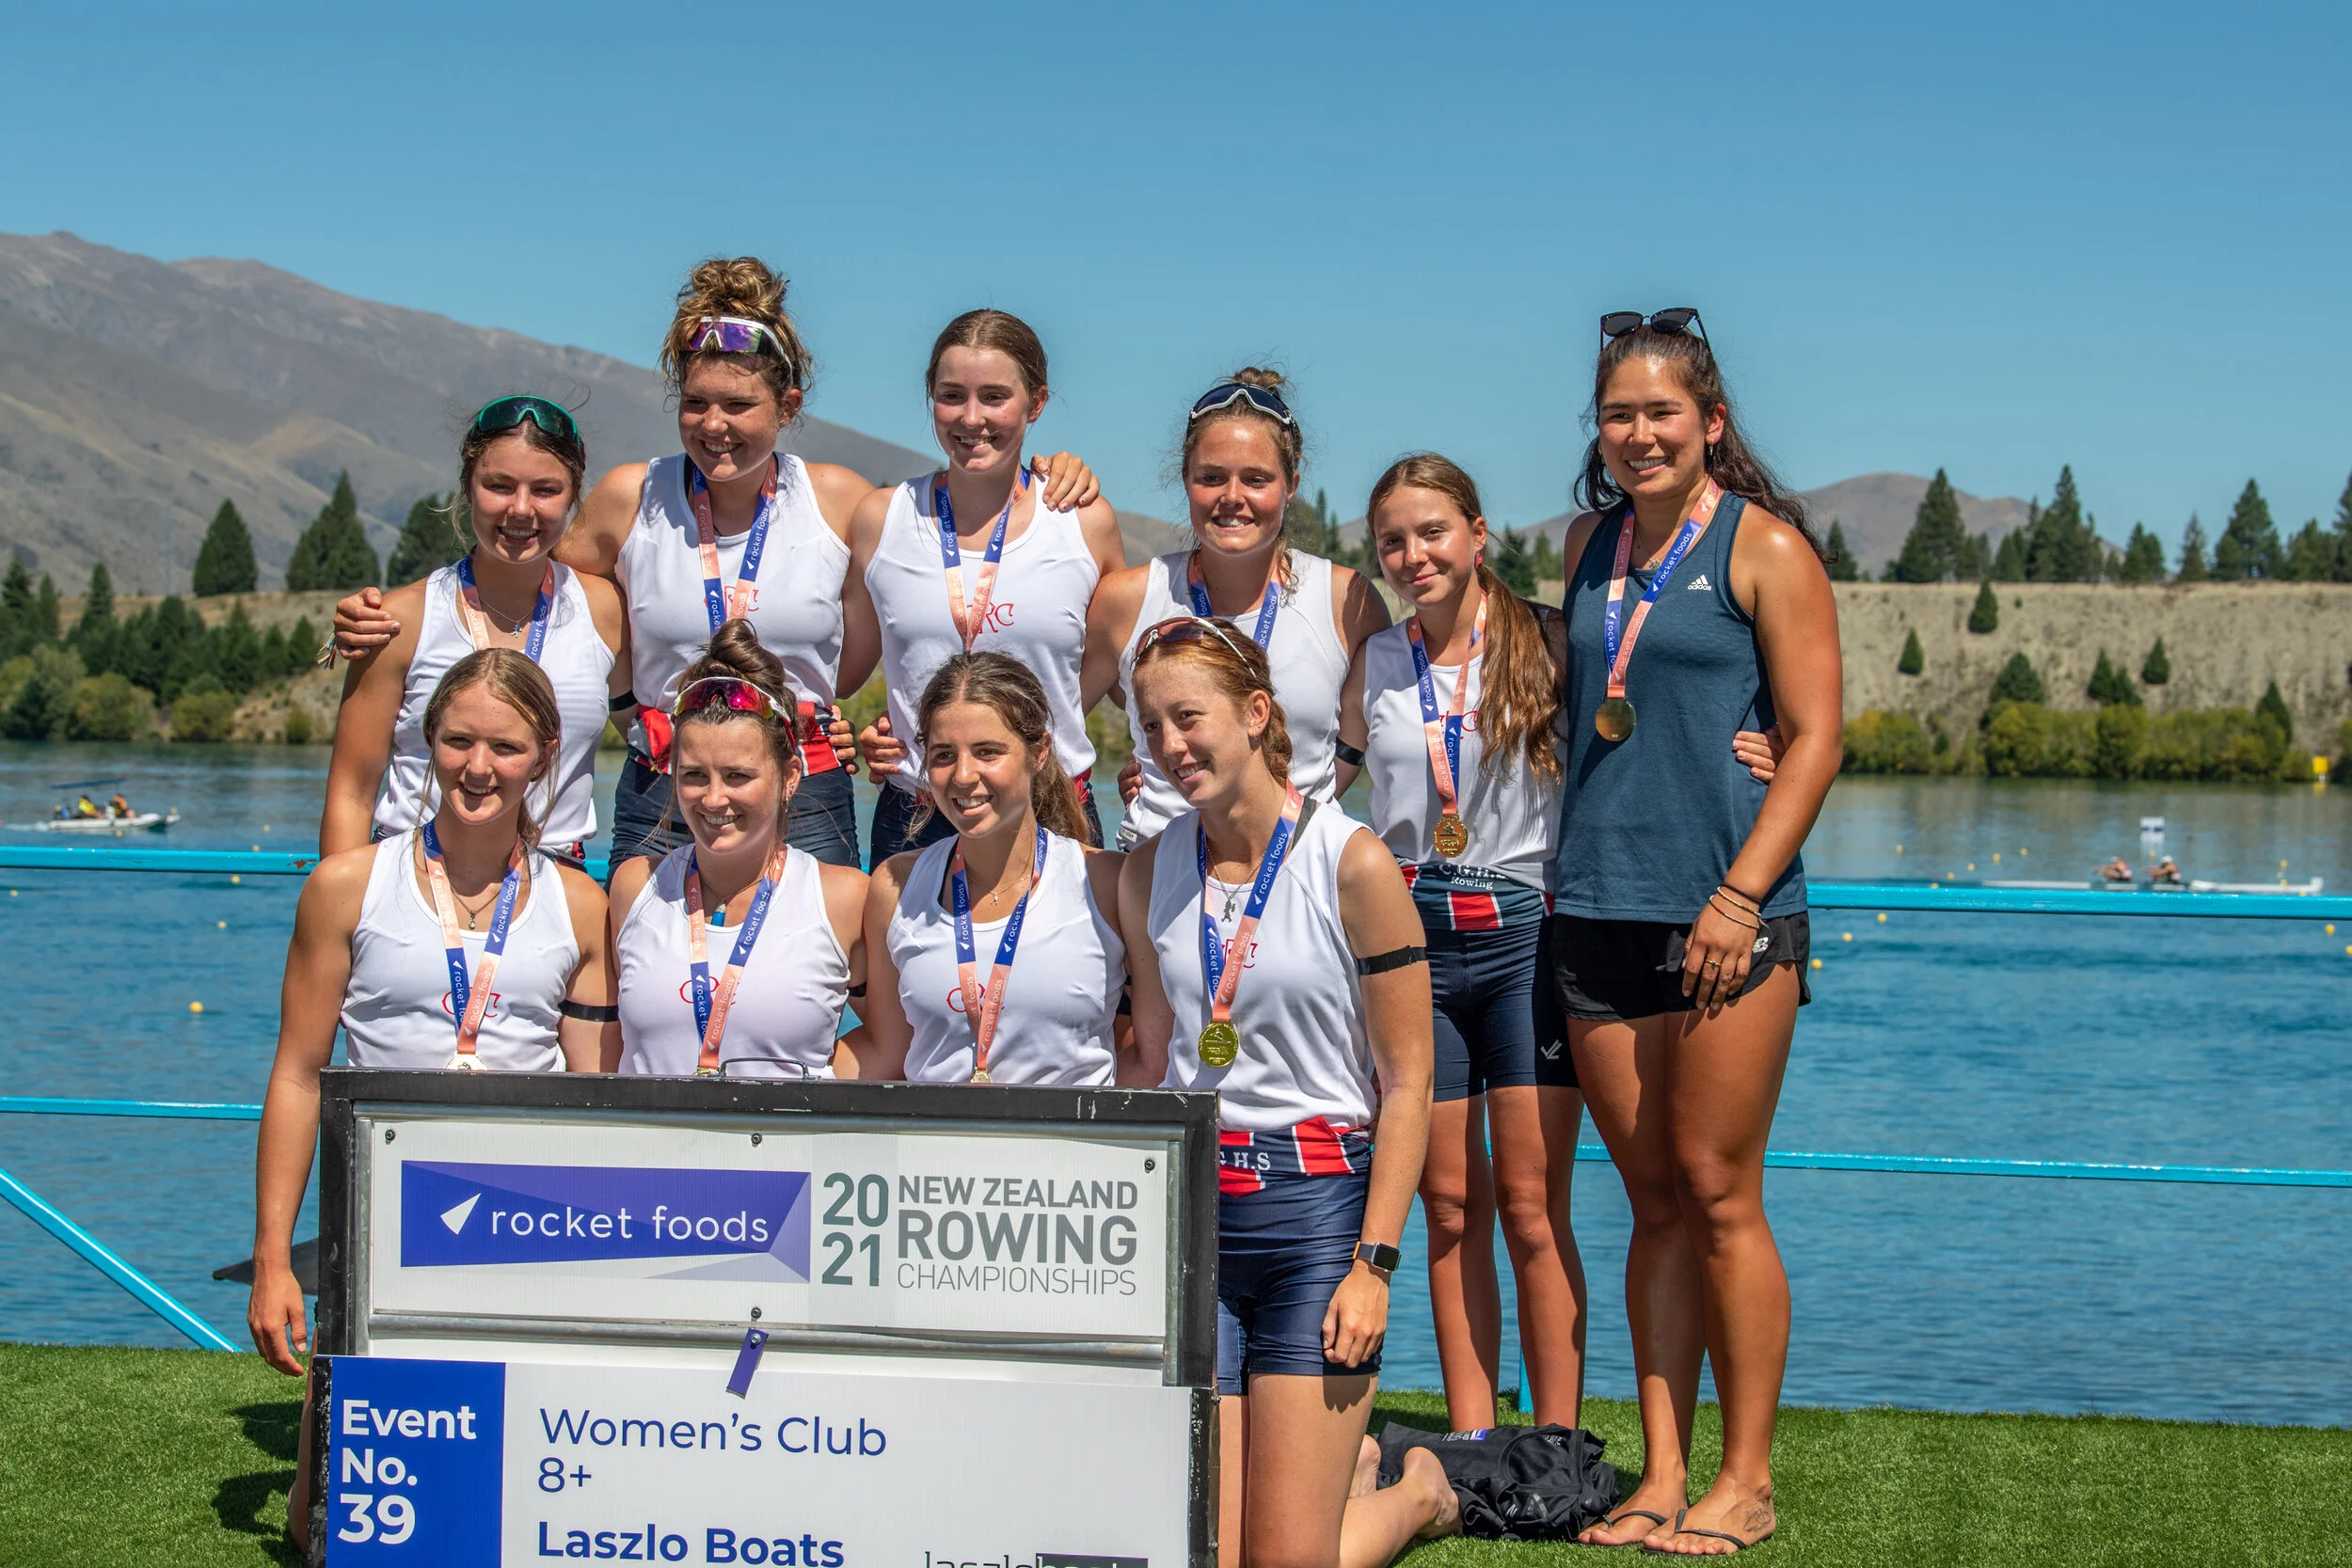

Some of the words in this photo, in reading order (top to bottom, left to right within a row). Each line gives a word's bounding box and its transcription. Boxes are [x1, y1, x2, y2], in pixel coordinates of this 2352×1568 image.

[941, 496, 950, 520] foods
[751, 532, 763, 562] rocket
[757, 507, 770, 531] foods
[943, 518, 953, 547] rocket
[994, 515, 1007, 543] rocket
[1617, 537, 1628, 565] rocket
[1658, 555, 1677, 584] rocket
[1674, 531, 1692, 556] foods
[1687, 583, 1712, 592] adidas
[536, 605, 548, 628] foods
[710, 599, 722, 630] rocket
[973, 601, 985, 631] rocket
[1198, 593, 1208, 616] foods
[1264, 594, 1278, 620] foods
[531, 629, 543, 656] rocket
[1608, 620, 1616, 653] rocket
[1618, 640, 1632, 672] rocket
[1629, 612, 1644, 638] foods
[1418, 650, 1427, 674] foods
[1422, 674, 1432, 703] rocket
[1431, 733, 1444, 759] foods
[1447, 737, 1455, 770] rocket
[1437, 758, 1452, 790] rocket
[1259, 860, 1277, 895] rocket
[1270, 832, 1288, 858] foods
[496, 905, 510, 935] rocket
[504, 879, 516, 905] foods
[691, 896, 699, 927] rocket
[958, 882, 966, 911] foods
[743, 916, 760, 946] rocket
[755, 891, 770, 914] foods
[961, 910, 971, 941] rocket
[1008, 911, 1023, 942] rocket
[1209, 937, 1220, 972] rocket
[1225, 959, 1243, 994] rocket
[1235, 930, 1251, 959] foods
[453, 971, 467, 1006] rocket
[469, 993, 485, 1026] rocket
[477, 965, 493, 992] foods
[696, 984, 707, 1018] rocket
[967, 975, 977, 1004] foods
[990, 978, 1004, 1006] foods
[711, 1009, 725, 1040] rocket
[719, 977, 734, 1006] foods
[984, 1006, 998, 1042] rocket
[822, 1172, 889, 1227] 20
[898, 1175, 976, 1205] NEW
[982, 1178, 1138, 1210] ZEALAND
[491, 1206, 633, 1239] rocket
[651, 1205, 770, 1243] foods
[898, 1209, 1137, 1266] ROWING
[821, 1231, 881, 1287] 21
[898, 1262, 1136, 1295] CHAMPIONSHIPS
[342, 1399, 477, 1439] Event
[539, 1408, 763, 1451] Women's
[777, 1416, 887, 1456] Club
[342, 1447, 418, 1486] No.
[538, 1457, 592, 1493] 8+
[338, 1493, 416, 1544] 39
[538, 1521, 689, 1561] Laszlo
[706, 1528, 845, 1568] Boats
